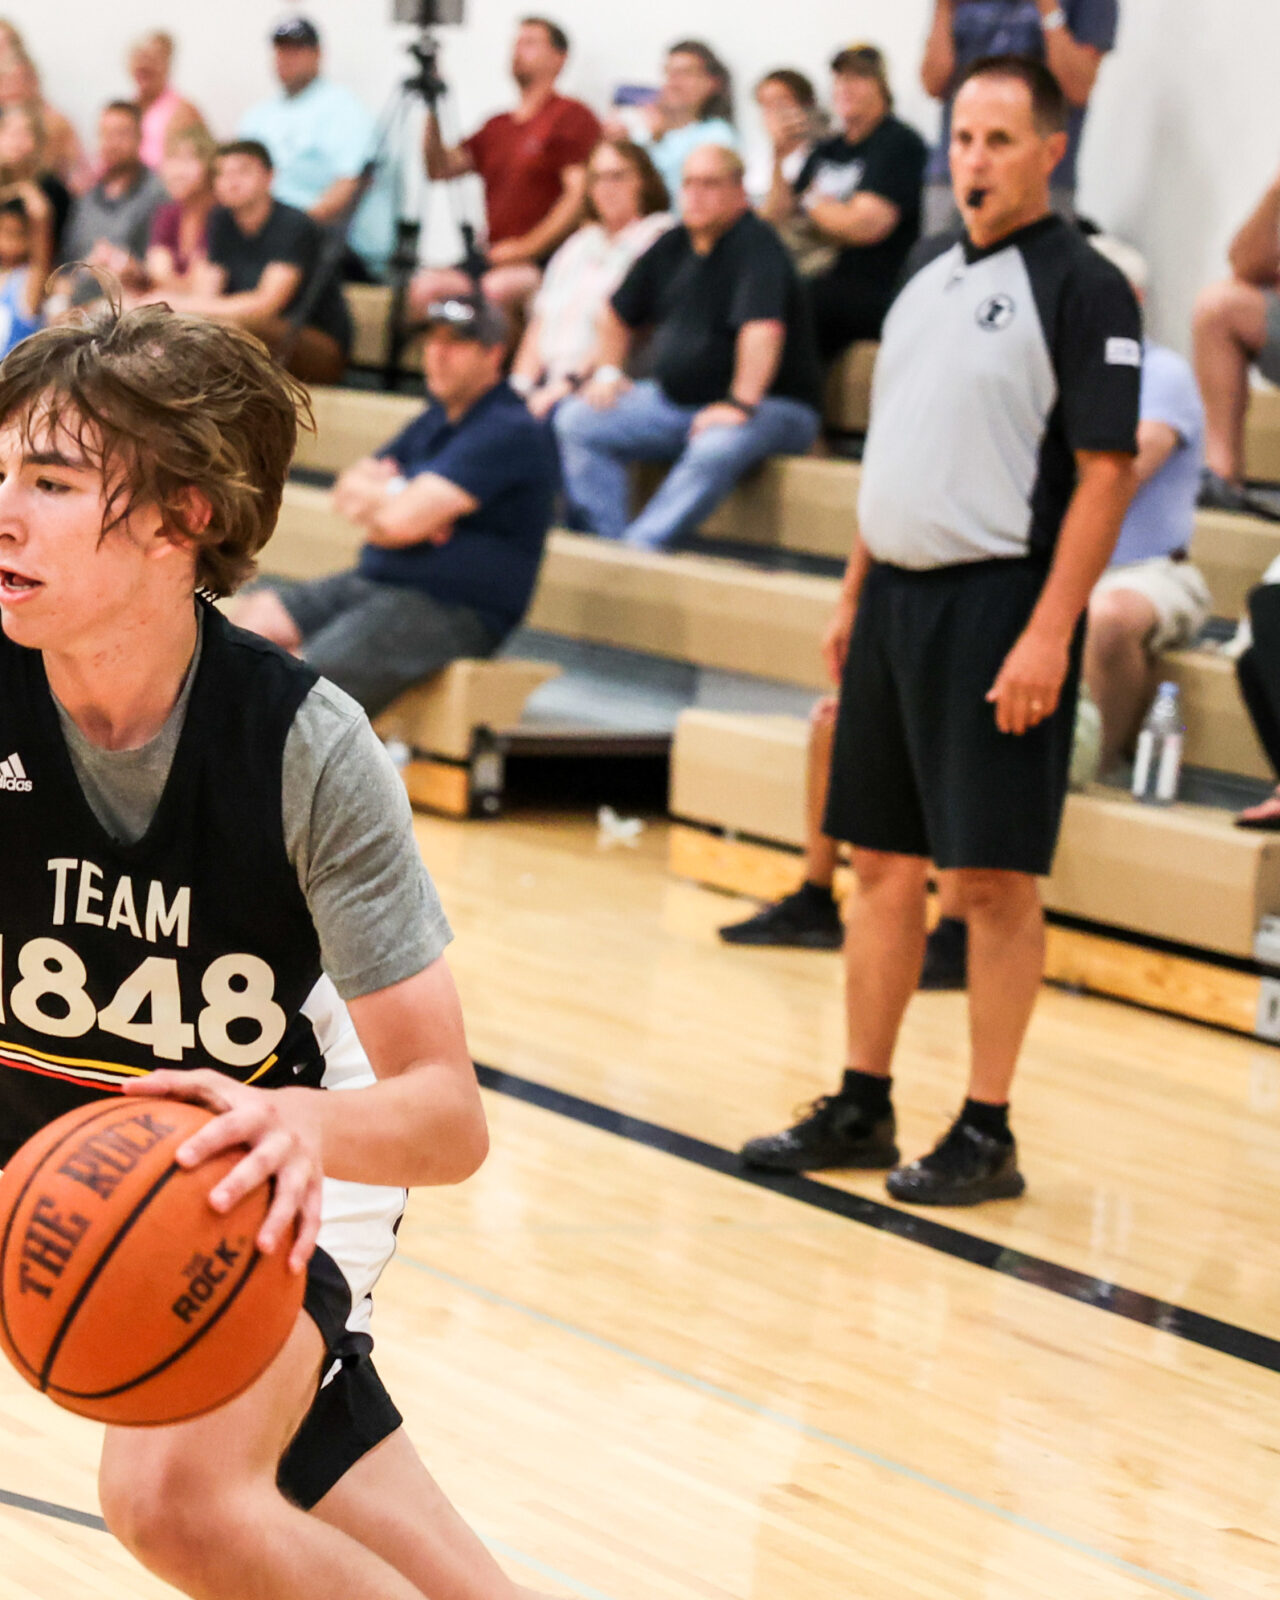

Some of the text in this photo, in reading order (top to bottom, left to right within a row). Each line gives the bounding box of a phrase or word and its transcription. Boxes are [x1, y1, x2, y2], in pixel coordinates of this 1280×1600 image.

[47, 857, 191, 948] TEAM
[19, 1114, 176, 1300] THE ROCK
[171, 1238, 241, 1323] ROCK
